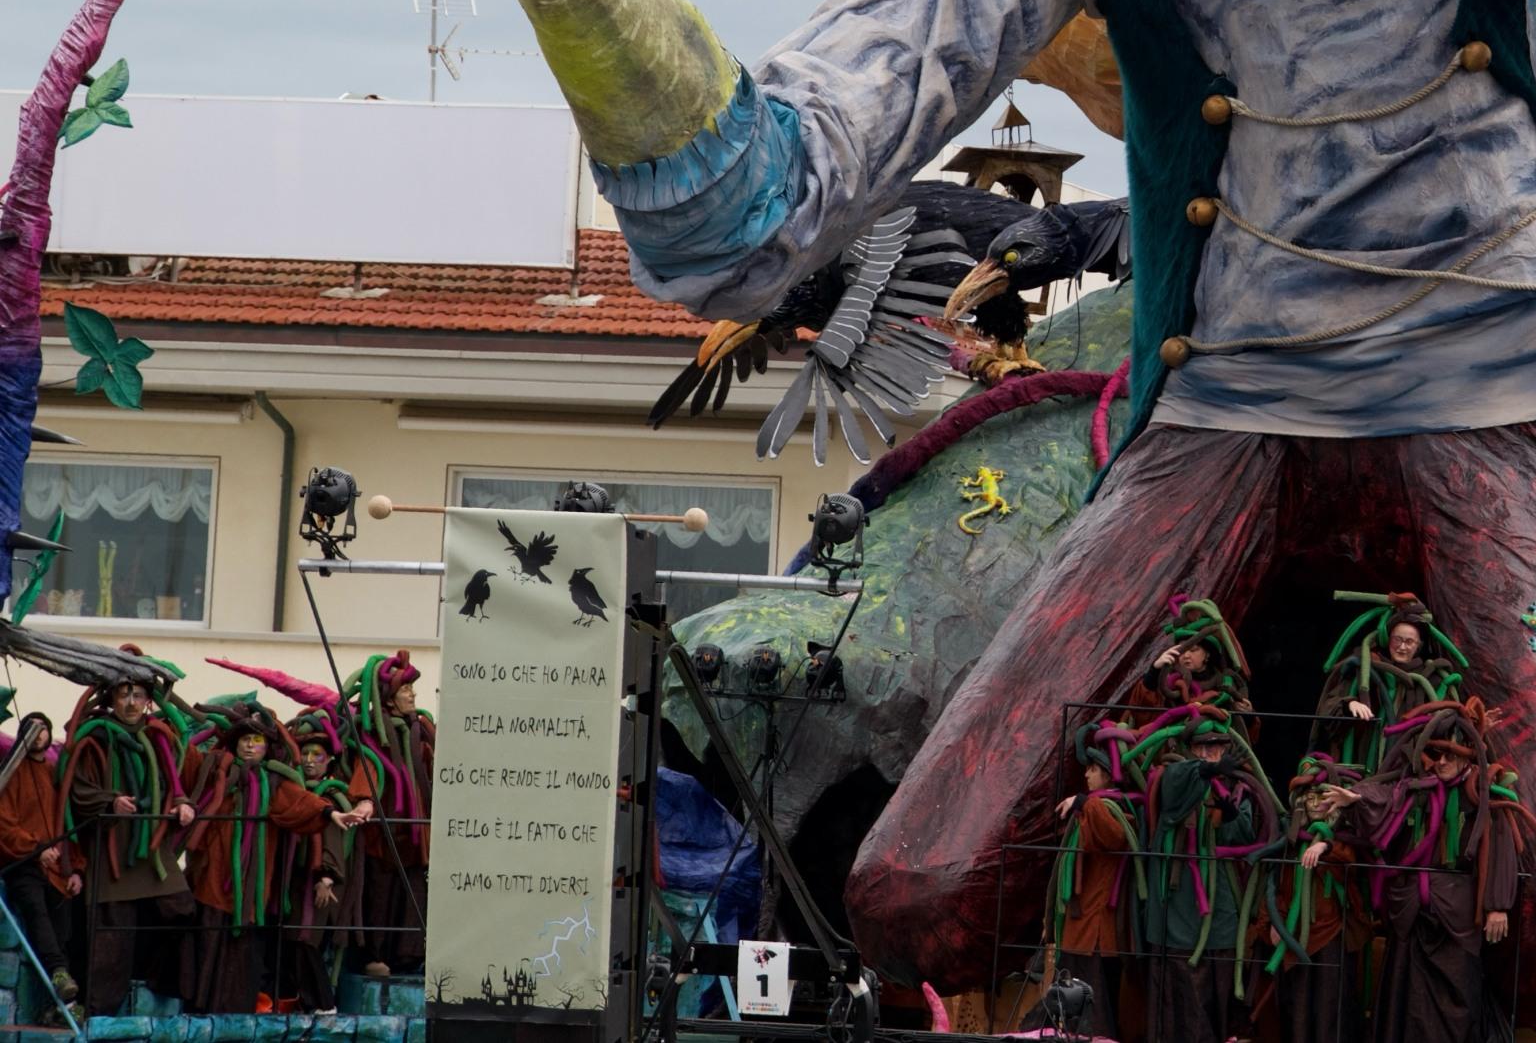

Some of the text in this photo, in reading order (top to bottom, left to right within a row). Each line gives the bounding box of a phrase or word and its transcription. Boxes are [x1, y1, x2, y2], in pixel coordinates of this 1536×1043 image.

[453, 662, 607, 687] SONO IO CHE HO PAURA
[464, 714, 504, 736] DELLA
[469, 768, 496, 786] CHE
[500, 768, 542, 788] RENDE
[546, 770, 561, 789] IL
[566, 772, 611, 790] MONDO
[447, 818, 489, 838] BELLO
[508, 821, 523, 840] IL
[527, 821, 567, 842] FATTO
[571, 824, 598, 843] CHE
[449, 872, 590, 896] SIAMO TUTTI DIVERSI
[756, 974, 768, 997] 1
